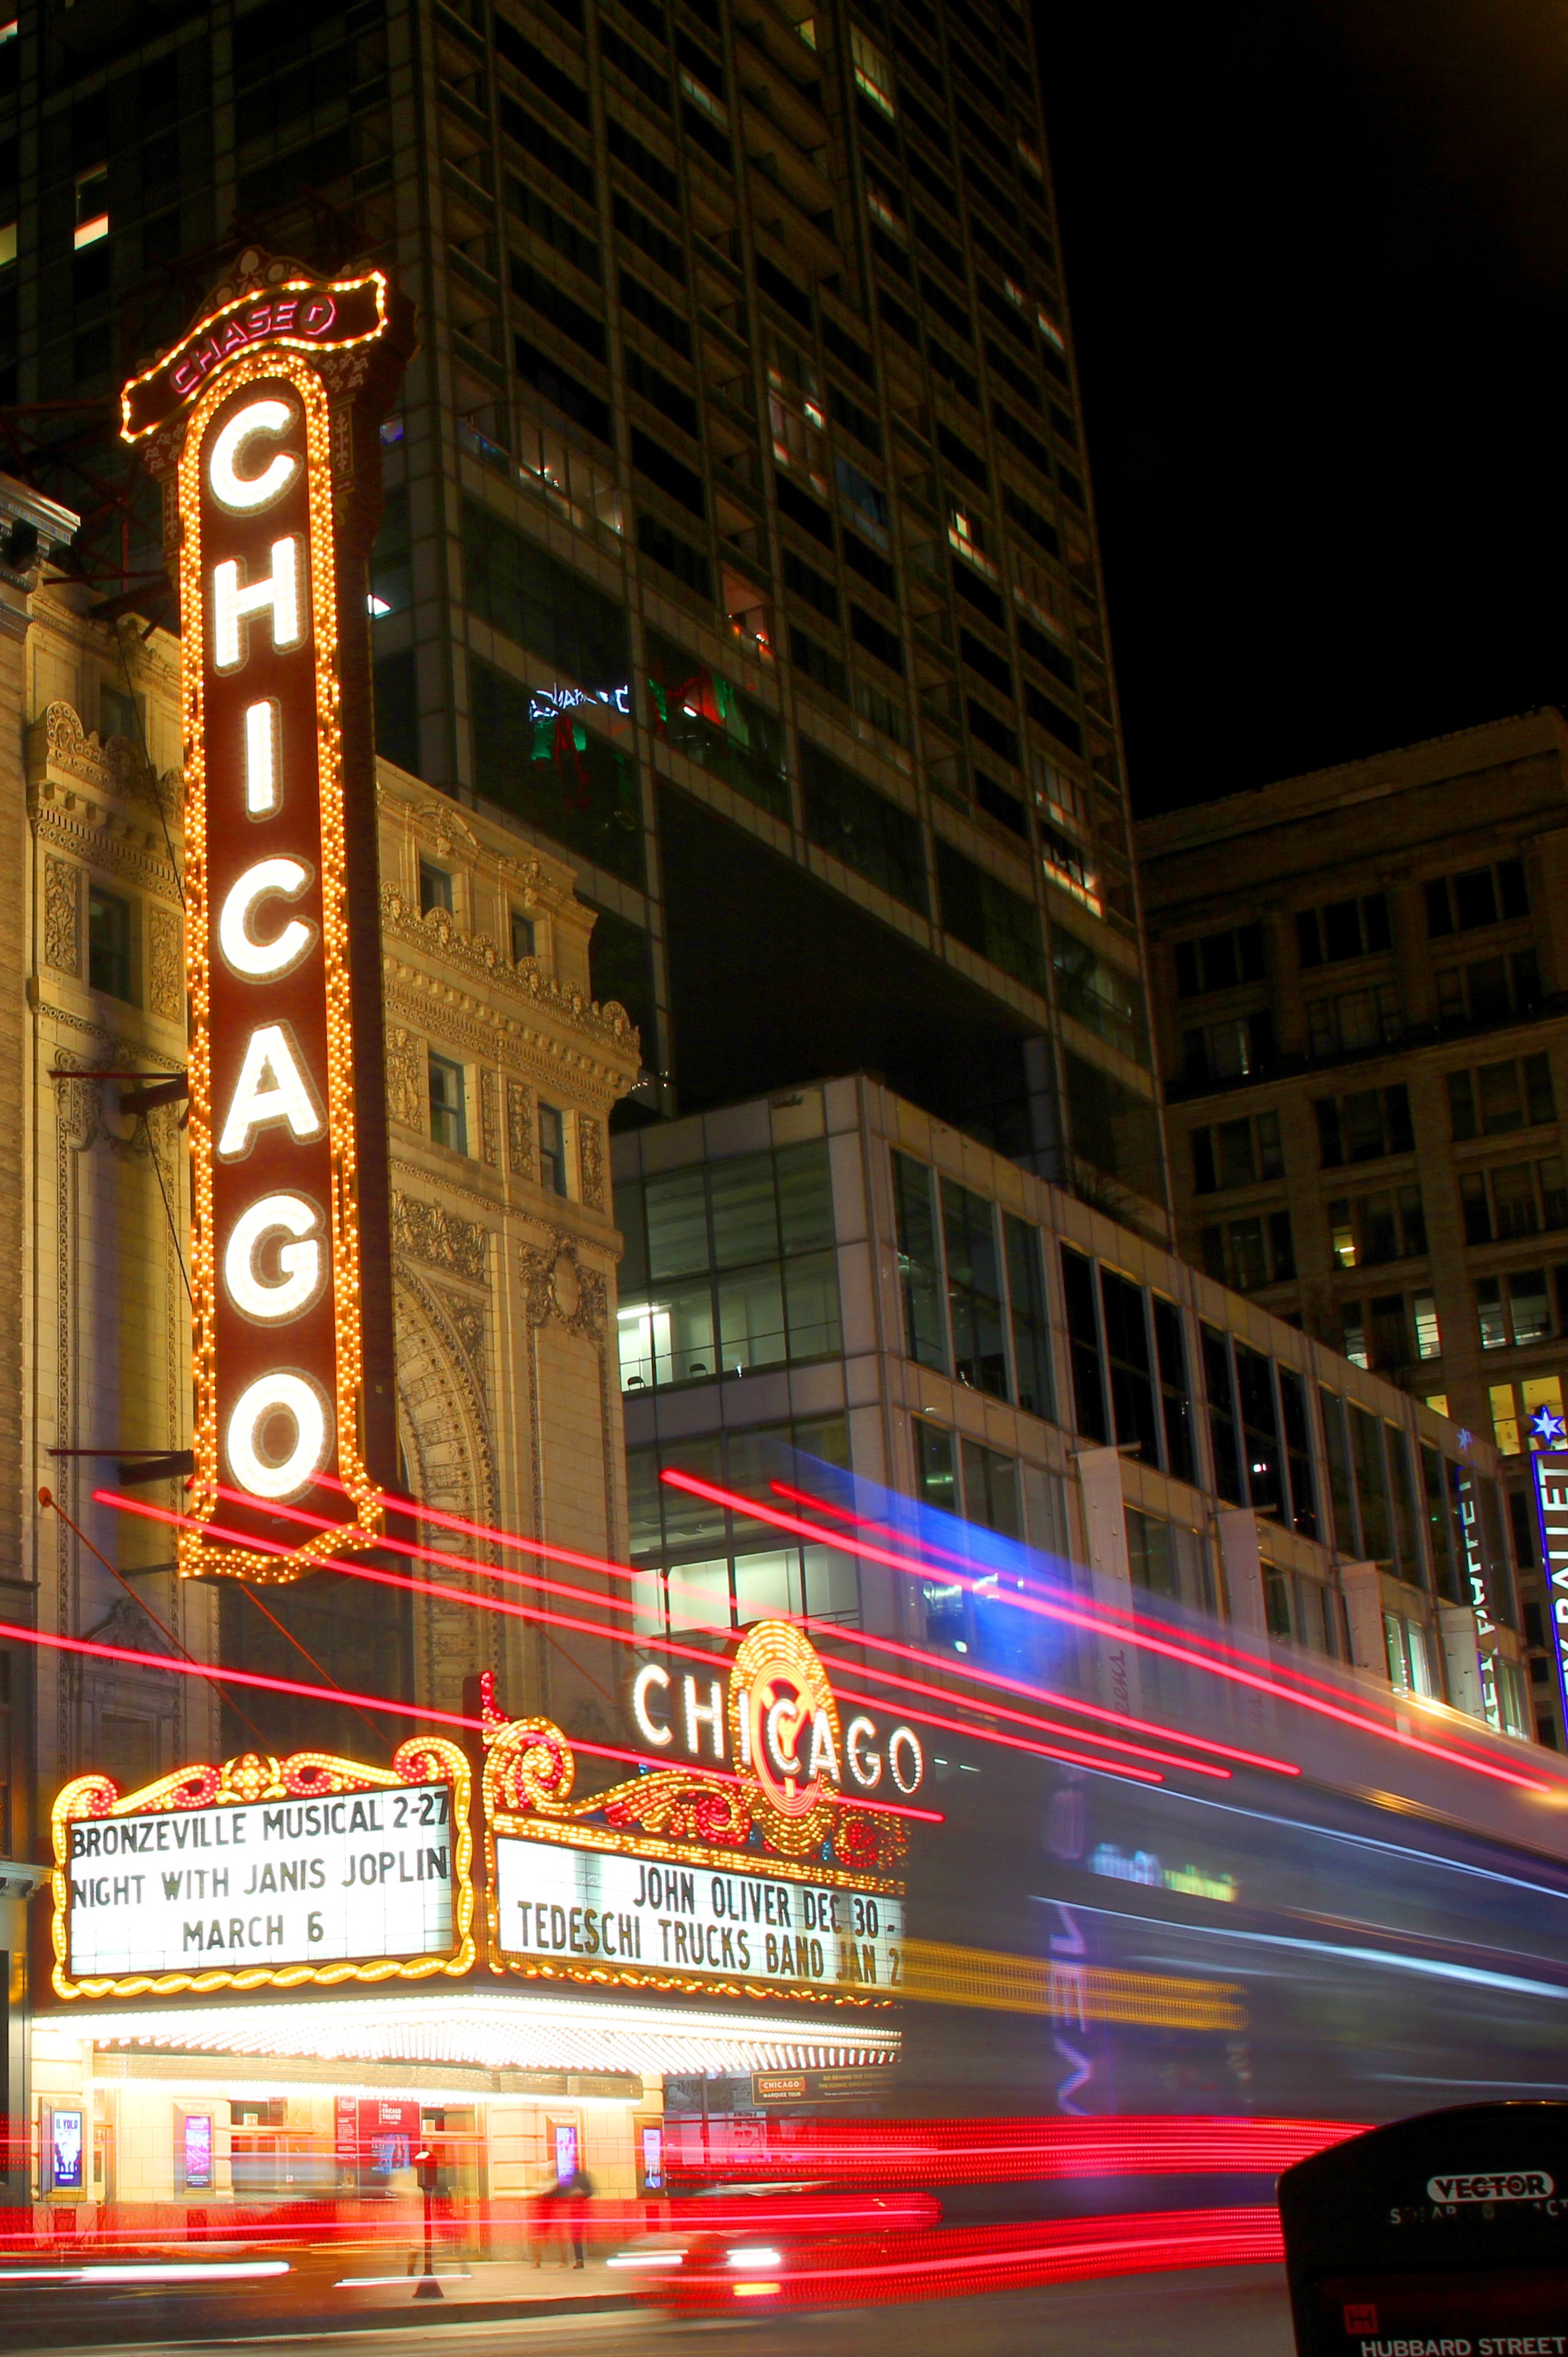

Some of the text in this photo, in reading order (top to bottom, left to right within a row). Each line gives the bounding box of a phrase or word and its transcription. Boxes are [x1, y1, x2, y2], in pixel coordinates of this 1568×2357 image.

[170, 300, 298, 393] CHASE
[210, 400, 326, 1497] CHICAGO
[633, 1663, 924, 1795] CHICAGO
[72, 1792, 448, 1857] BRONZEVILLE MUSICAL 2-27
[71, 1846, 448, 1909] NIGHT WITH JANIS JOPLIN
[633, 1864, 695, 1915] JOHN
[713, 1876, 791, 1928] OLIVER
[803, 1890, 843, 1934] DEC
[183, 1911, 324, 1951] MARCH 6
[518, 1900, 641, 1959] TEDESCHI
[658, 1919, 750, 1971] TRUCKS
[765, 1932, 824, 1979] BAND
[836, 1941, 877, 1984] JAN
[763, 2080, 800, 2089] CHICAGO
[1434, 2174, 1547, 2199] VECTOR
[1360, 2336, 1567, 2357] HUBBARD STREET
